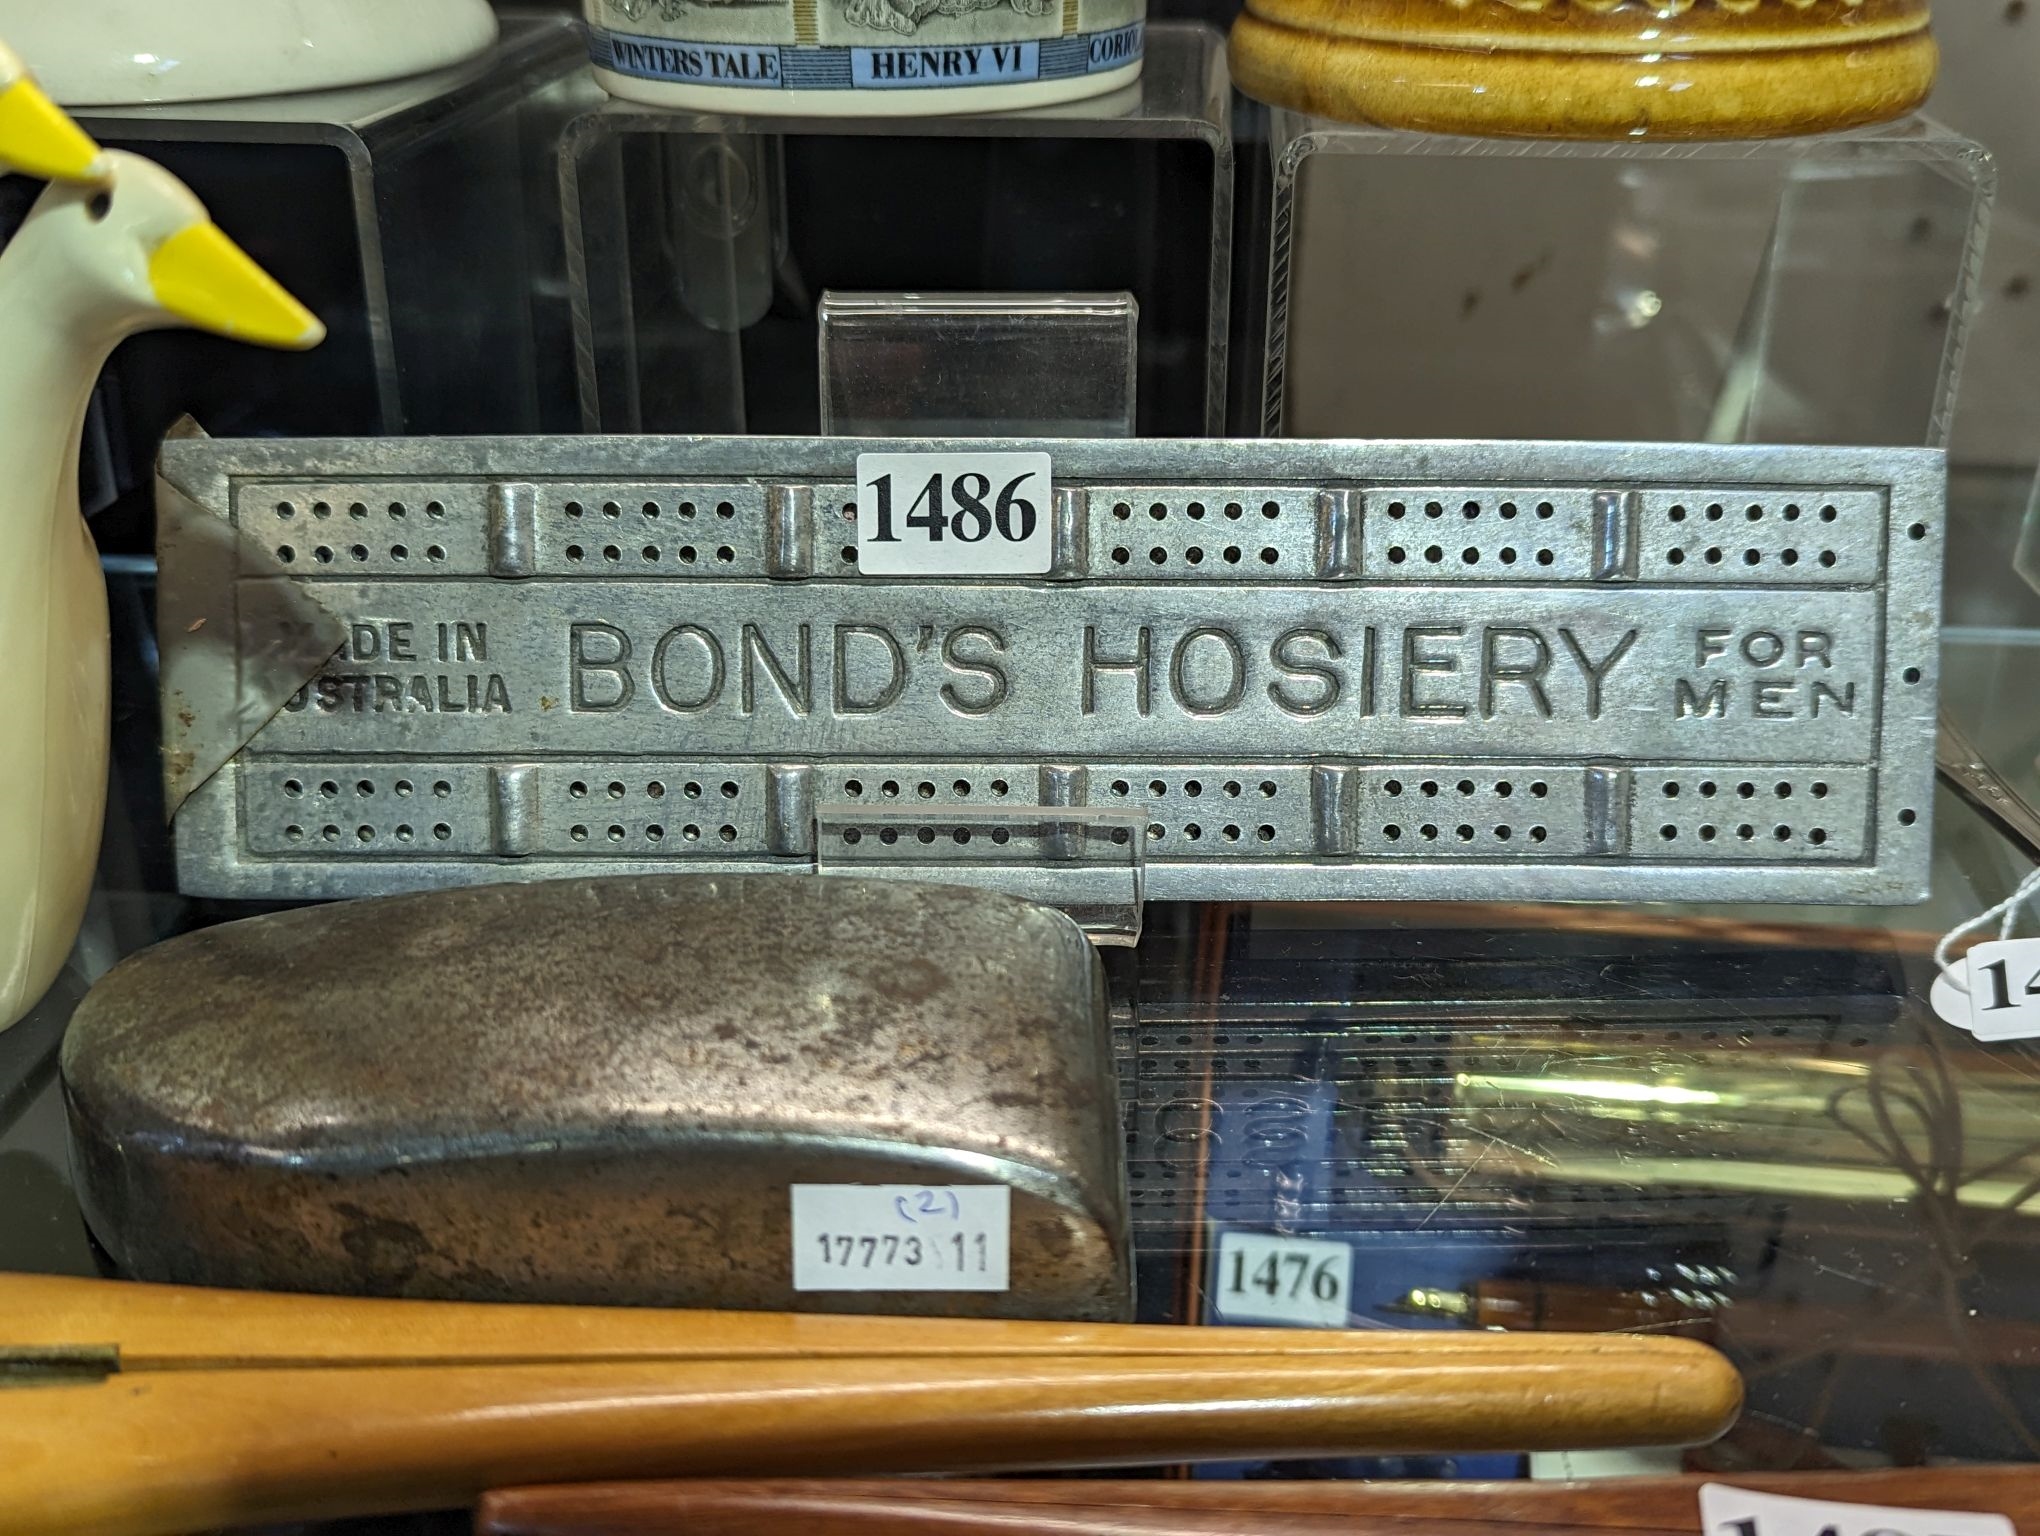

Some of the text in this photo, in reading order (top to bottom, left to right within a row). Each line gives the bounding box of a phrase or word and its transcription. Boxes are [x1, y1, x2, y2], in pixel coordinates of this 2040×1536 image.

[612, 39, 778, 80] WINTERS TALE
[871, 44, 1022, 79] HENRY VI
[866, 471, 1037, 543] 1486
[320, 621, 487, 663] DE IN
[1695, 628, 1834, 671] FOR
[570, 624, 1637, 720] BOND'S HOSIERY
[1673, 679, 1856, 720] MEN
[894, 1190, 960, 1223] (2)
[818, 1231, 987, 1272] 17773 11
[1224, 1247, 1342, 1301] 1476
